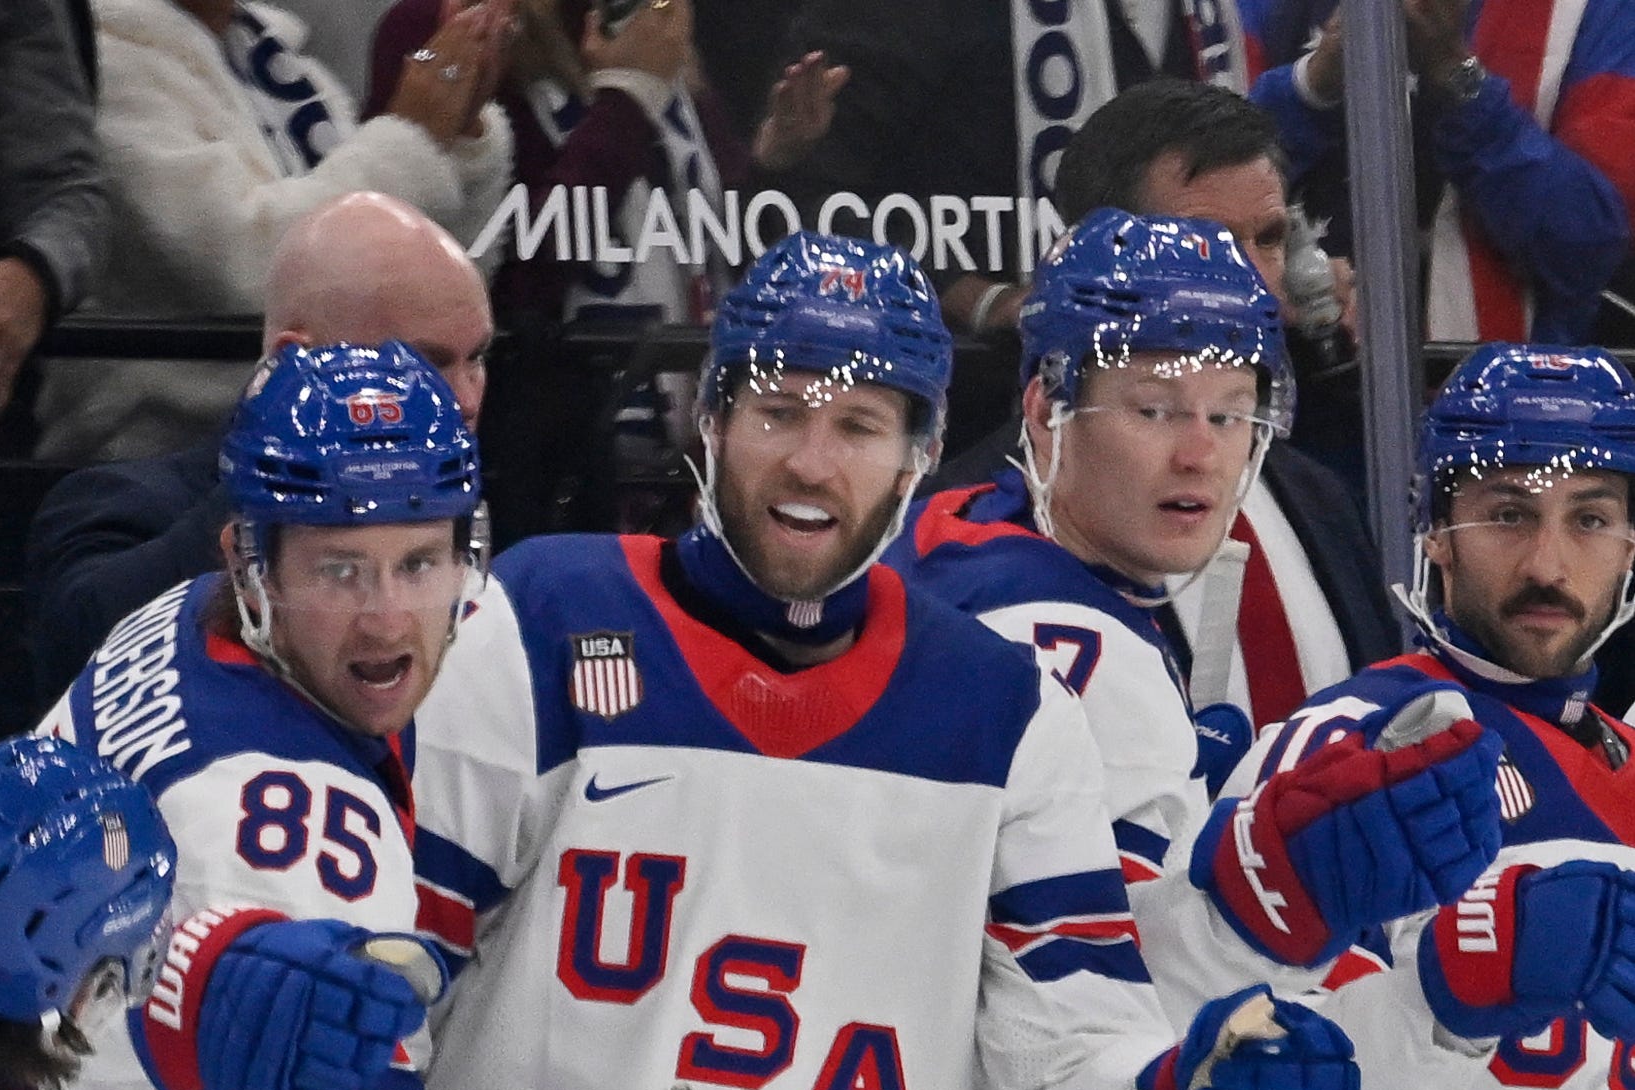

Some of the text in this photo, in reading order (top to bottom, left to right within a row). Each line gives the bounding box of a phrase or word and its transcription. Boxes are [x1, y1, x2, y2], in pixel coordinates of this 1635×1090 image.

[468, 183, 802, 266] MILANO
[90, 579, 193, 782] NDERSON
[581, 637, 625, 657] USA
[1033, 622, 1102, 696] 7
[236, 769, 381, 901] 85
